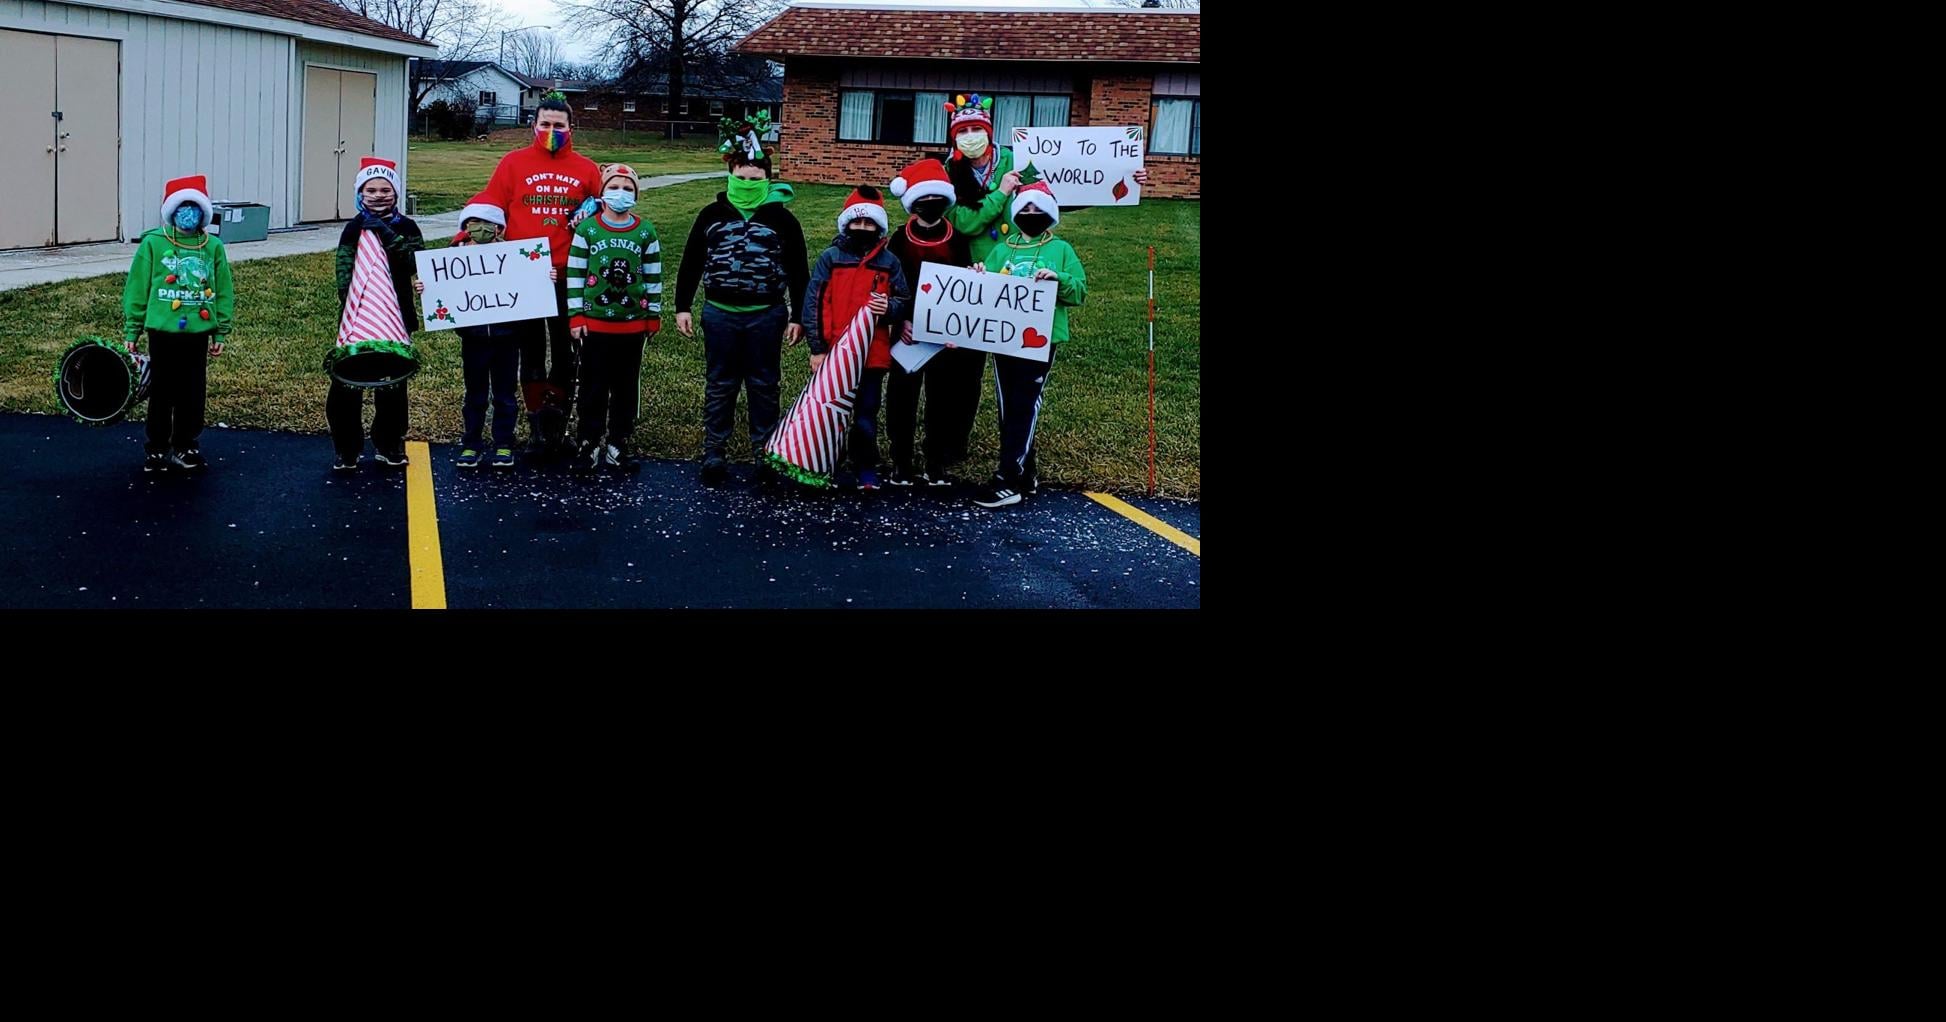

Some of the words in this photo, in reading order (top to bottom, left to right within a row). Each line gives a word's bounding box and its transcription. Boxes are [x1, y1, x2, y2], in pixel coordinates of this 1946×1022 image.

[1028, 136, 1061, 156] JOY
[1077, 139, 1097, 155] TO
[1109, 140, 1139, 158] THE
[366, 167, 394, 180] GAVIN
[525, 173, 554, 185] DON'T
[556, 174, 581, 187] HATE
[1043, 168, 1104, 185] WORLD
[536, 185, 550, 193] ON
[553, 186, 569, 194] MY
[590, 240, 609, 255] OH
[431, 254, 507, 282] HOLLY
[158, 288, 194, 300] PACK
[456, 290, 518, 312] JOLLY
[935, 274, 983, 305] YOU
[994, 283, 1045, 313] ARE
[926, 309, 1016, 344] LOVED
